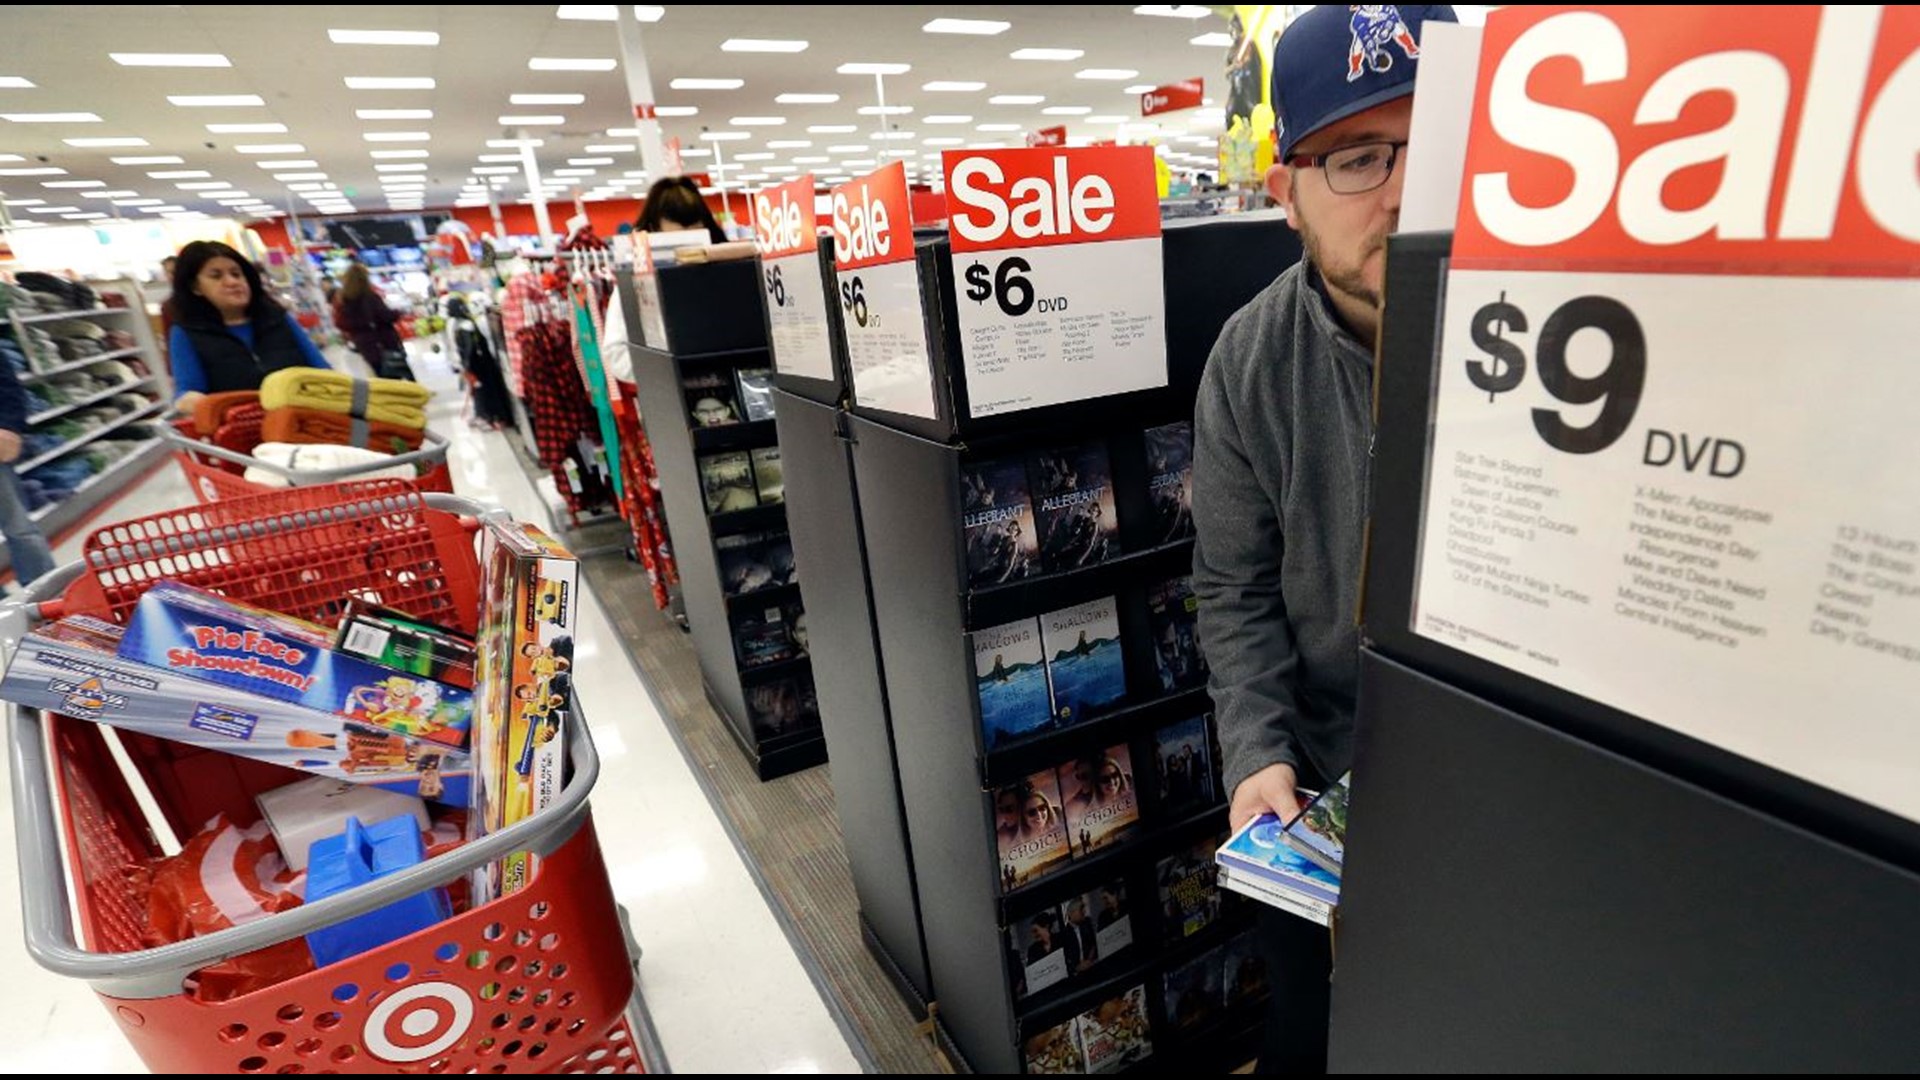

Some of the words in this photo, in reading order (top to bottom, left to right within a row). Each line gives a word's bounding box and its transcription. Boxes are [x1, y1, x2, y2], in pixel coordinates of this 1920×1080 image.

[756, 189, 802, 254] Sale
[950, 155, 1116, 243] Sale
[833, 183, 891, 264] Sale
[765, 264, 786, 307] $6
[842, 275, 868, 328] $6
[964, 256, 1035, 317] $6
[1037, 296, 1068, 313] DVD
[1465, 291, 1648, 455] $9
[1643, 429, 1747, 479] DVD
[1041, 485, 1106, 513] ALLEGIANT
[194, 625, 241, 651] Pie
[242, 630, 305, 666] Face
[166, 647, 317, 693] Showdown!
[1083, 797, 1134, 829] CHOICE
[1008, 829, 1063, 864] CHOICE
